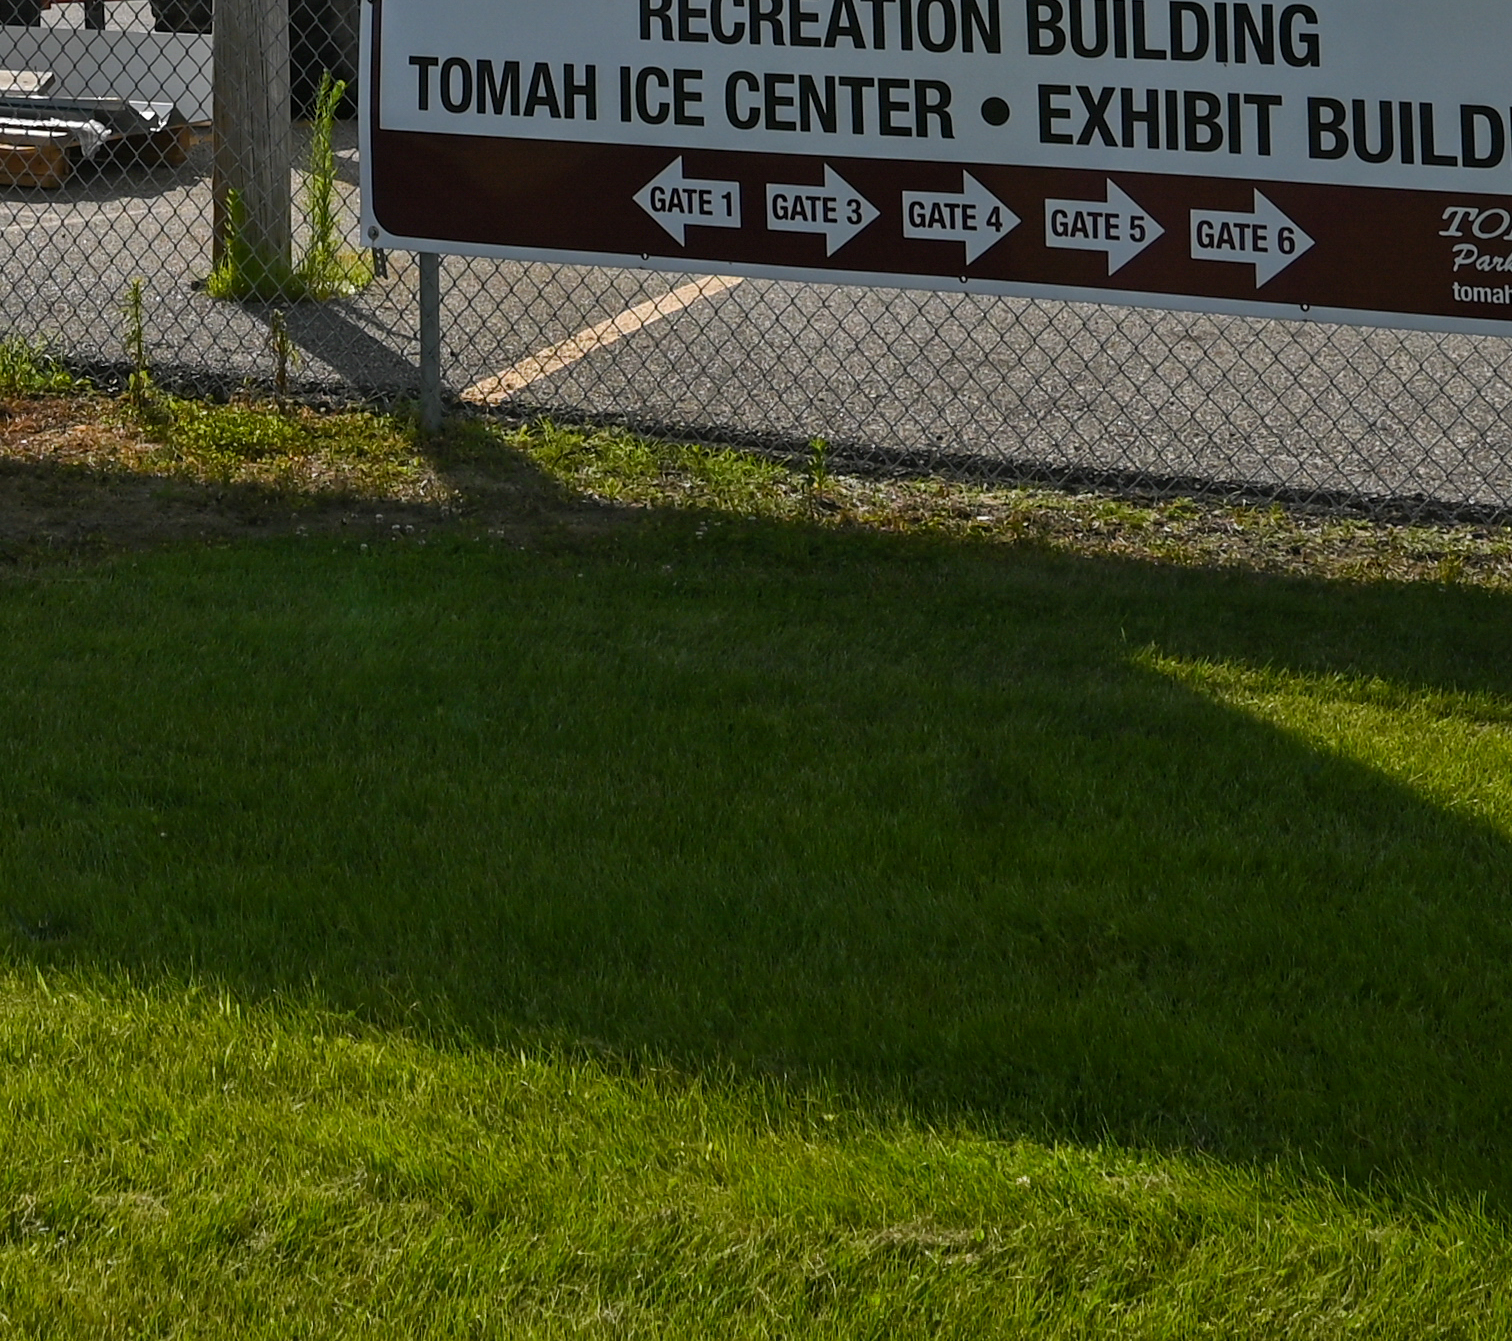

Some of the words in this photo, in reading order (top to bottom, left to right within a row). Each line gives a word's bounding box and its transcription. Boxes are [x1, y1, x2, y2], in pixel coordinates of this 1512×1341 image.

[409, 56, 596, 120] TOMAH
[620, 66, 704, 126] ICE
[725, 71, 955, 139] CENTER
[1038, 84, 1282, 156] EXHIBIT
[650, 186, 713, 216] GATE
[720, 191, 733, 217] 1
[771, 193, 838, 224] GATE
[846, 199, 863, 225] 3
[908, 201, 978, 232] GATE
[986, 206, 1003, 233] 4
[1050, 209, 1120, 241] GATE
[1129, 215, 1146, 243] 5
[1196, 220, 1269, 253] GATE
[1277, 227, 1296, 255] 6
